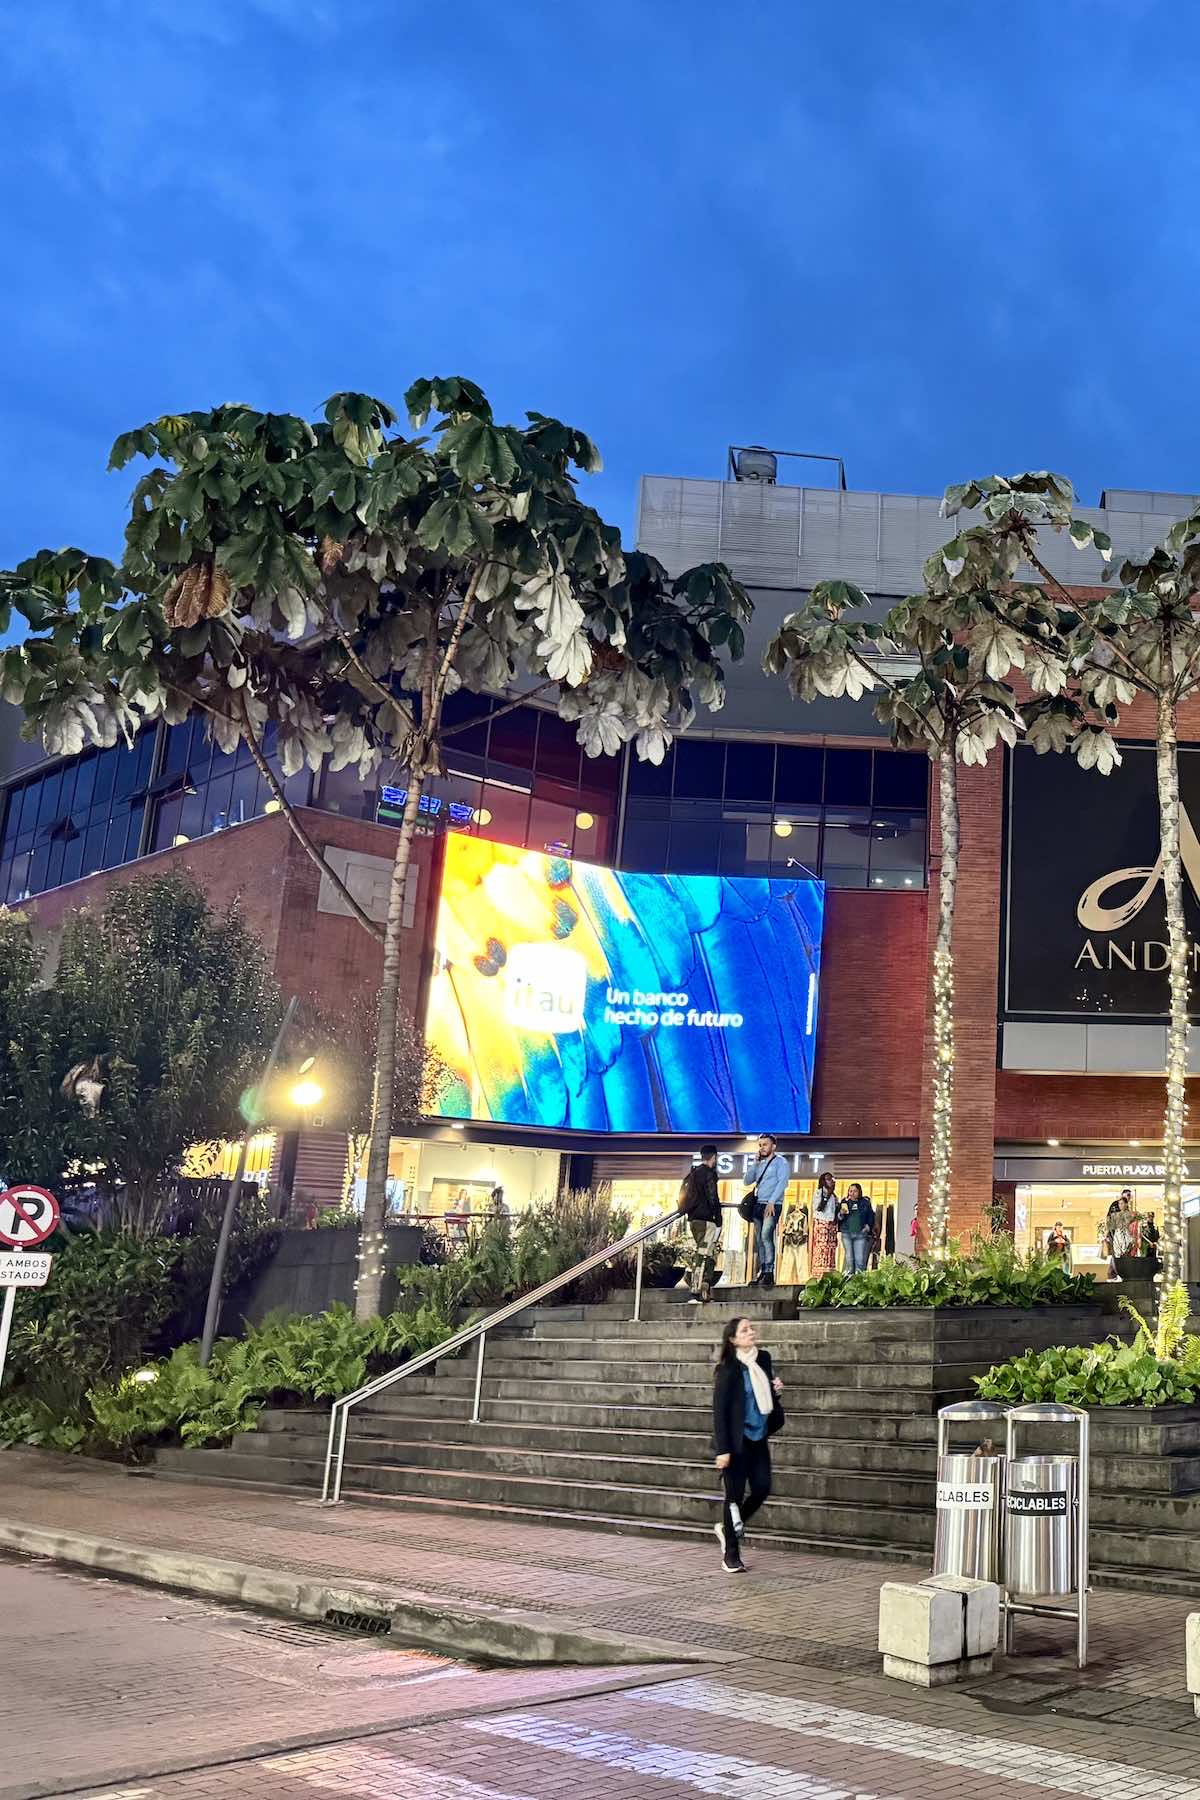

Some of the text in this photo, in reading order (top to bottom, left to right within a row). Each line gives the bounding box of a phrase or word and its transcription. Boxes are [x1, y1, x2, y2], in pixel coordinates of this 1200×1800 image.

[606, 987, 688, 1006] Un banco
[605, 1006, 743, 1027] hecho de futuro
[1082, 1164, 1122, 1175] PUERTA
[1123, 1165, 1155, 1175] PLAZA
[6, 1259, 47, 1268] AMBOS
